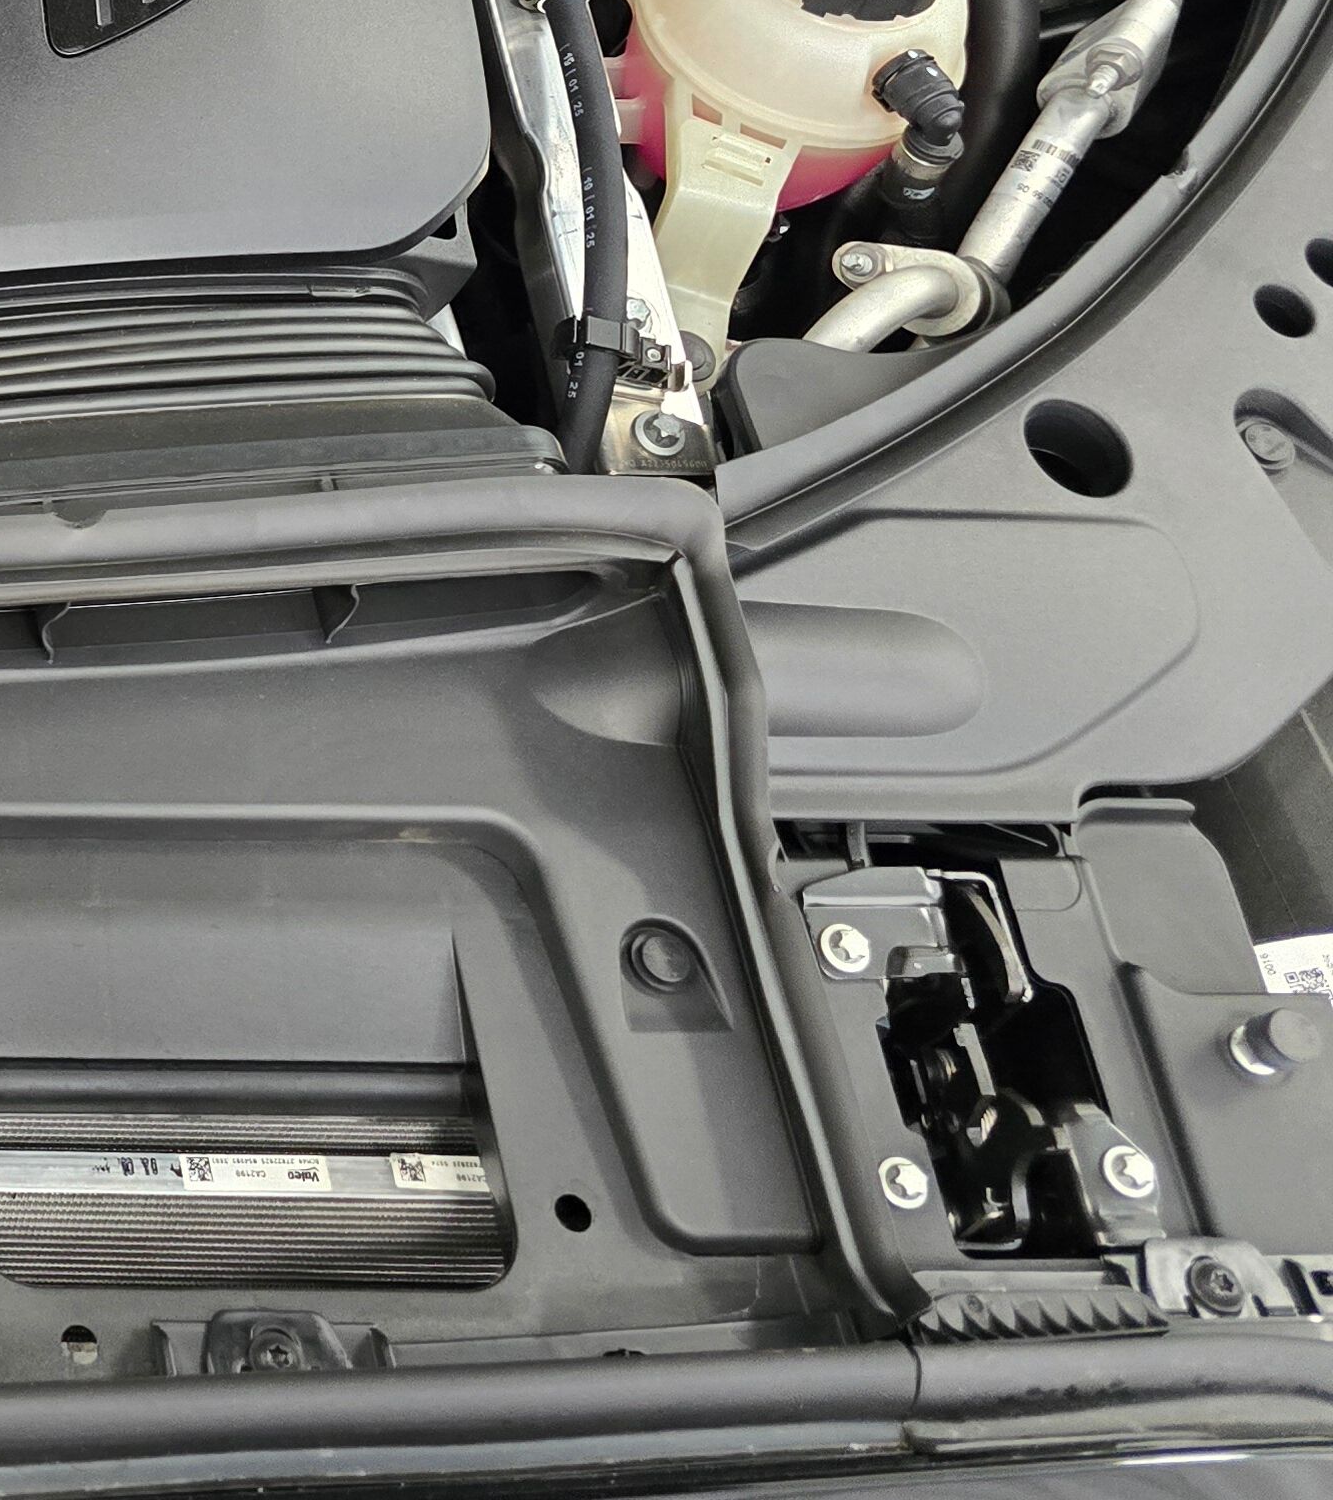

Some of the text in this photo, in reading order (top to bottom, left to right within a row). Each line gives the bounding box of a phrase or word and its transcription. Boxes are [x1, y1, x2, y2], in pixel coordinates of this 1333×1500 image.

[567, 78, 578, 93] 01
[582, 205, 596, 221] 01
[566, 381, 578, 398] 25
[287, 1171, 318, 1181] Valeo
